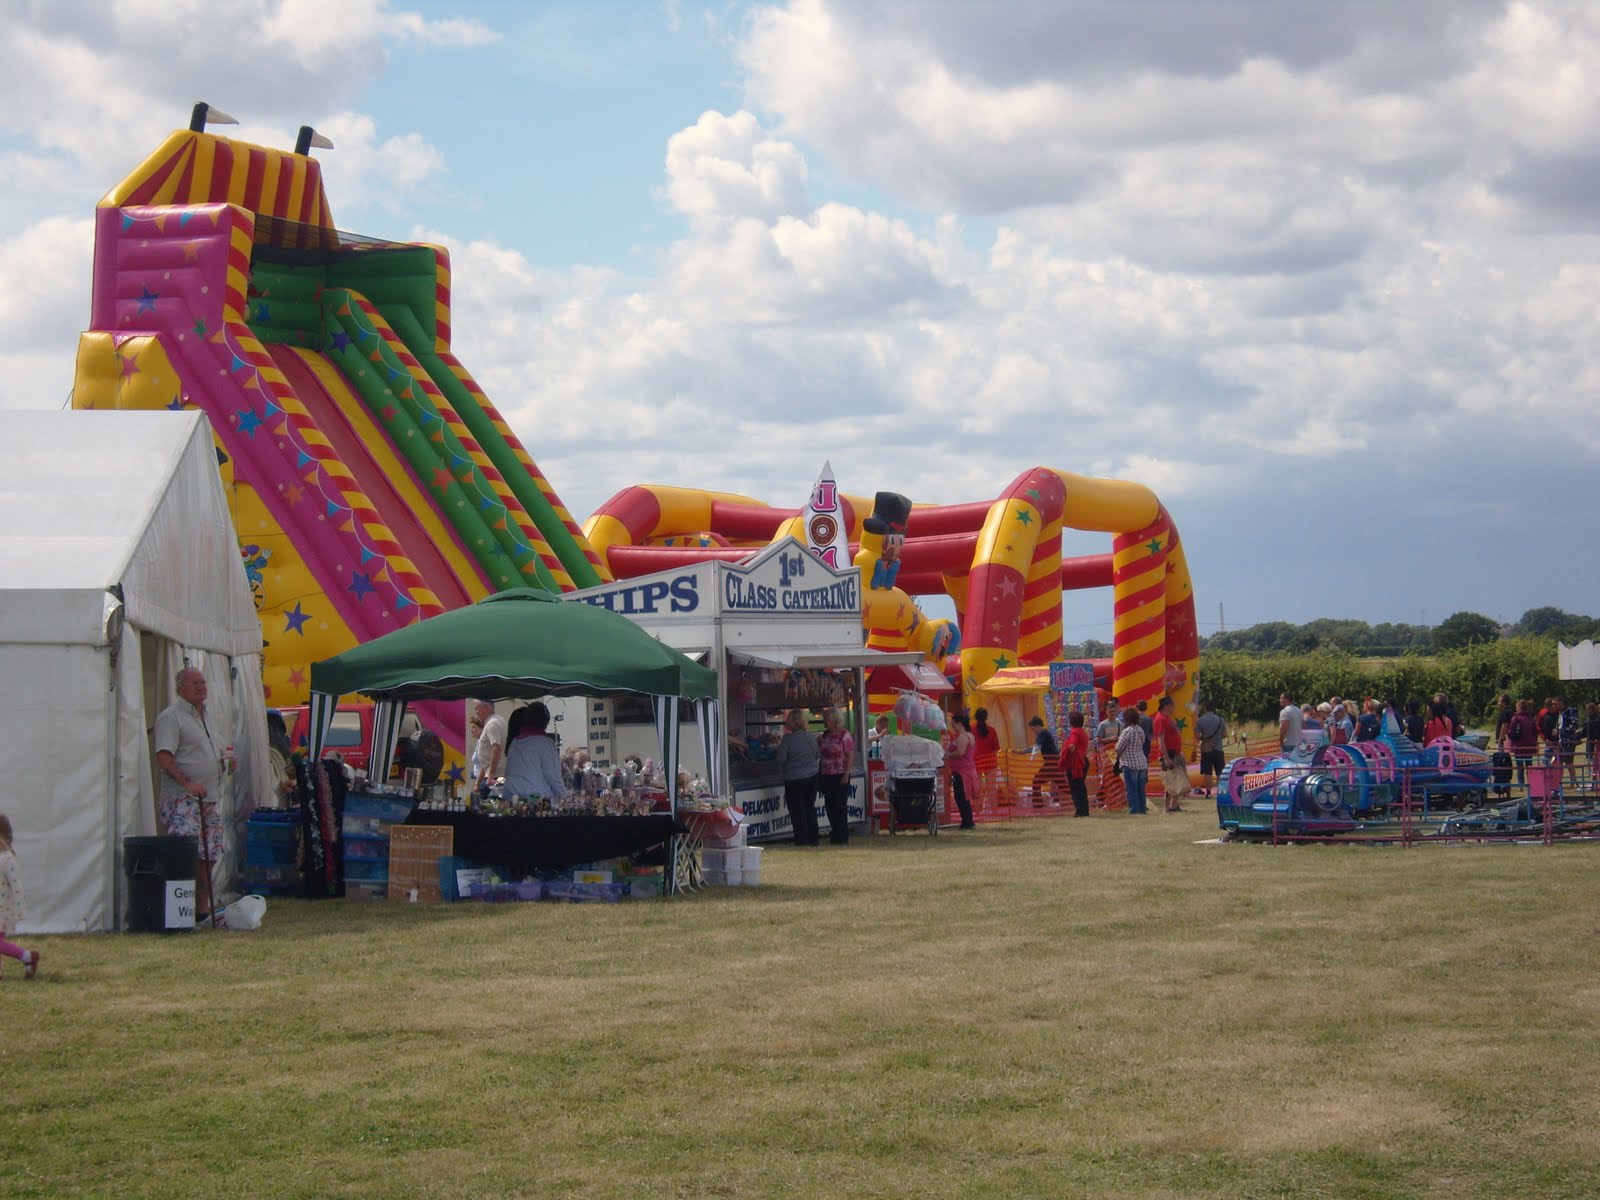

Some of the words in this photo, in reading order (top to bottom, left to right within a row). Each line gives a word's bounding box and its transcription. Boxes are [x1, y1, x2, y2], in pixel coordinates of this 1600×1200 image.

[779, 551, 805, 587] 1st
[565, 574, 699, 614] HIPS
[725, 571, 777, 609] CLASS
[782, 576, 857, 610] CATERING
[742, 794, 781, 816] DELICIOUS
[772, 814, 793, 831] TREAT
